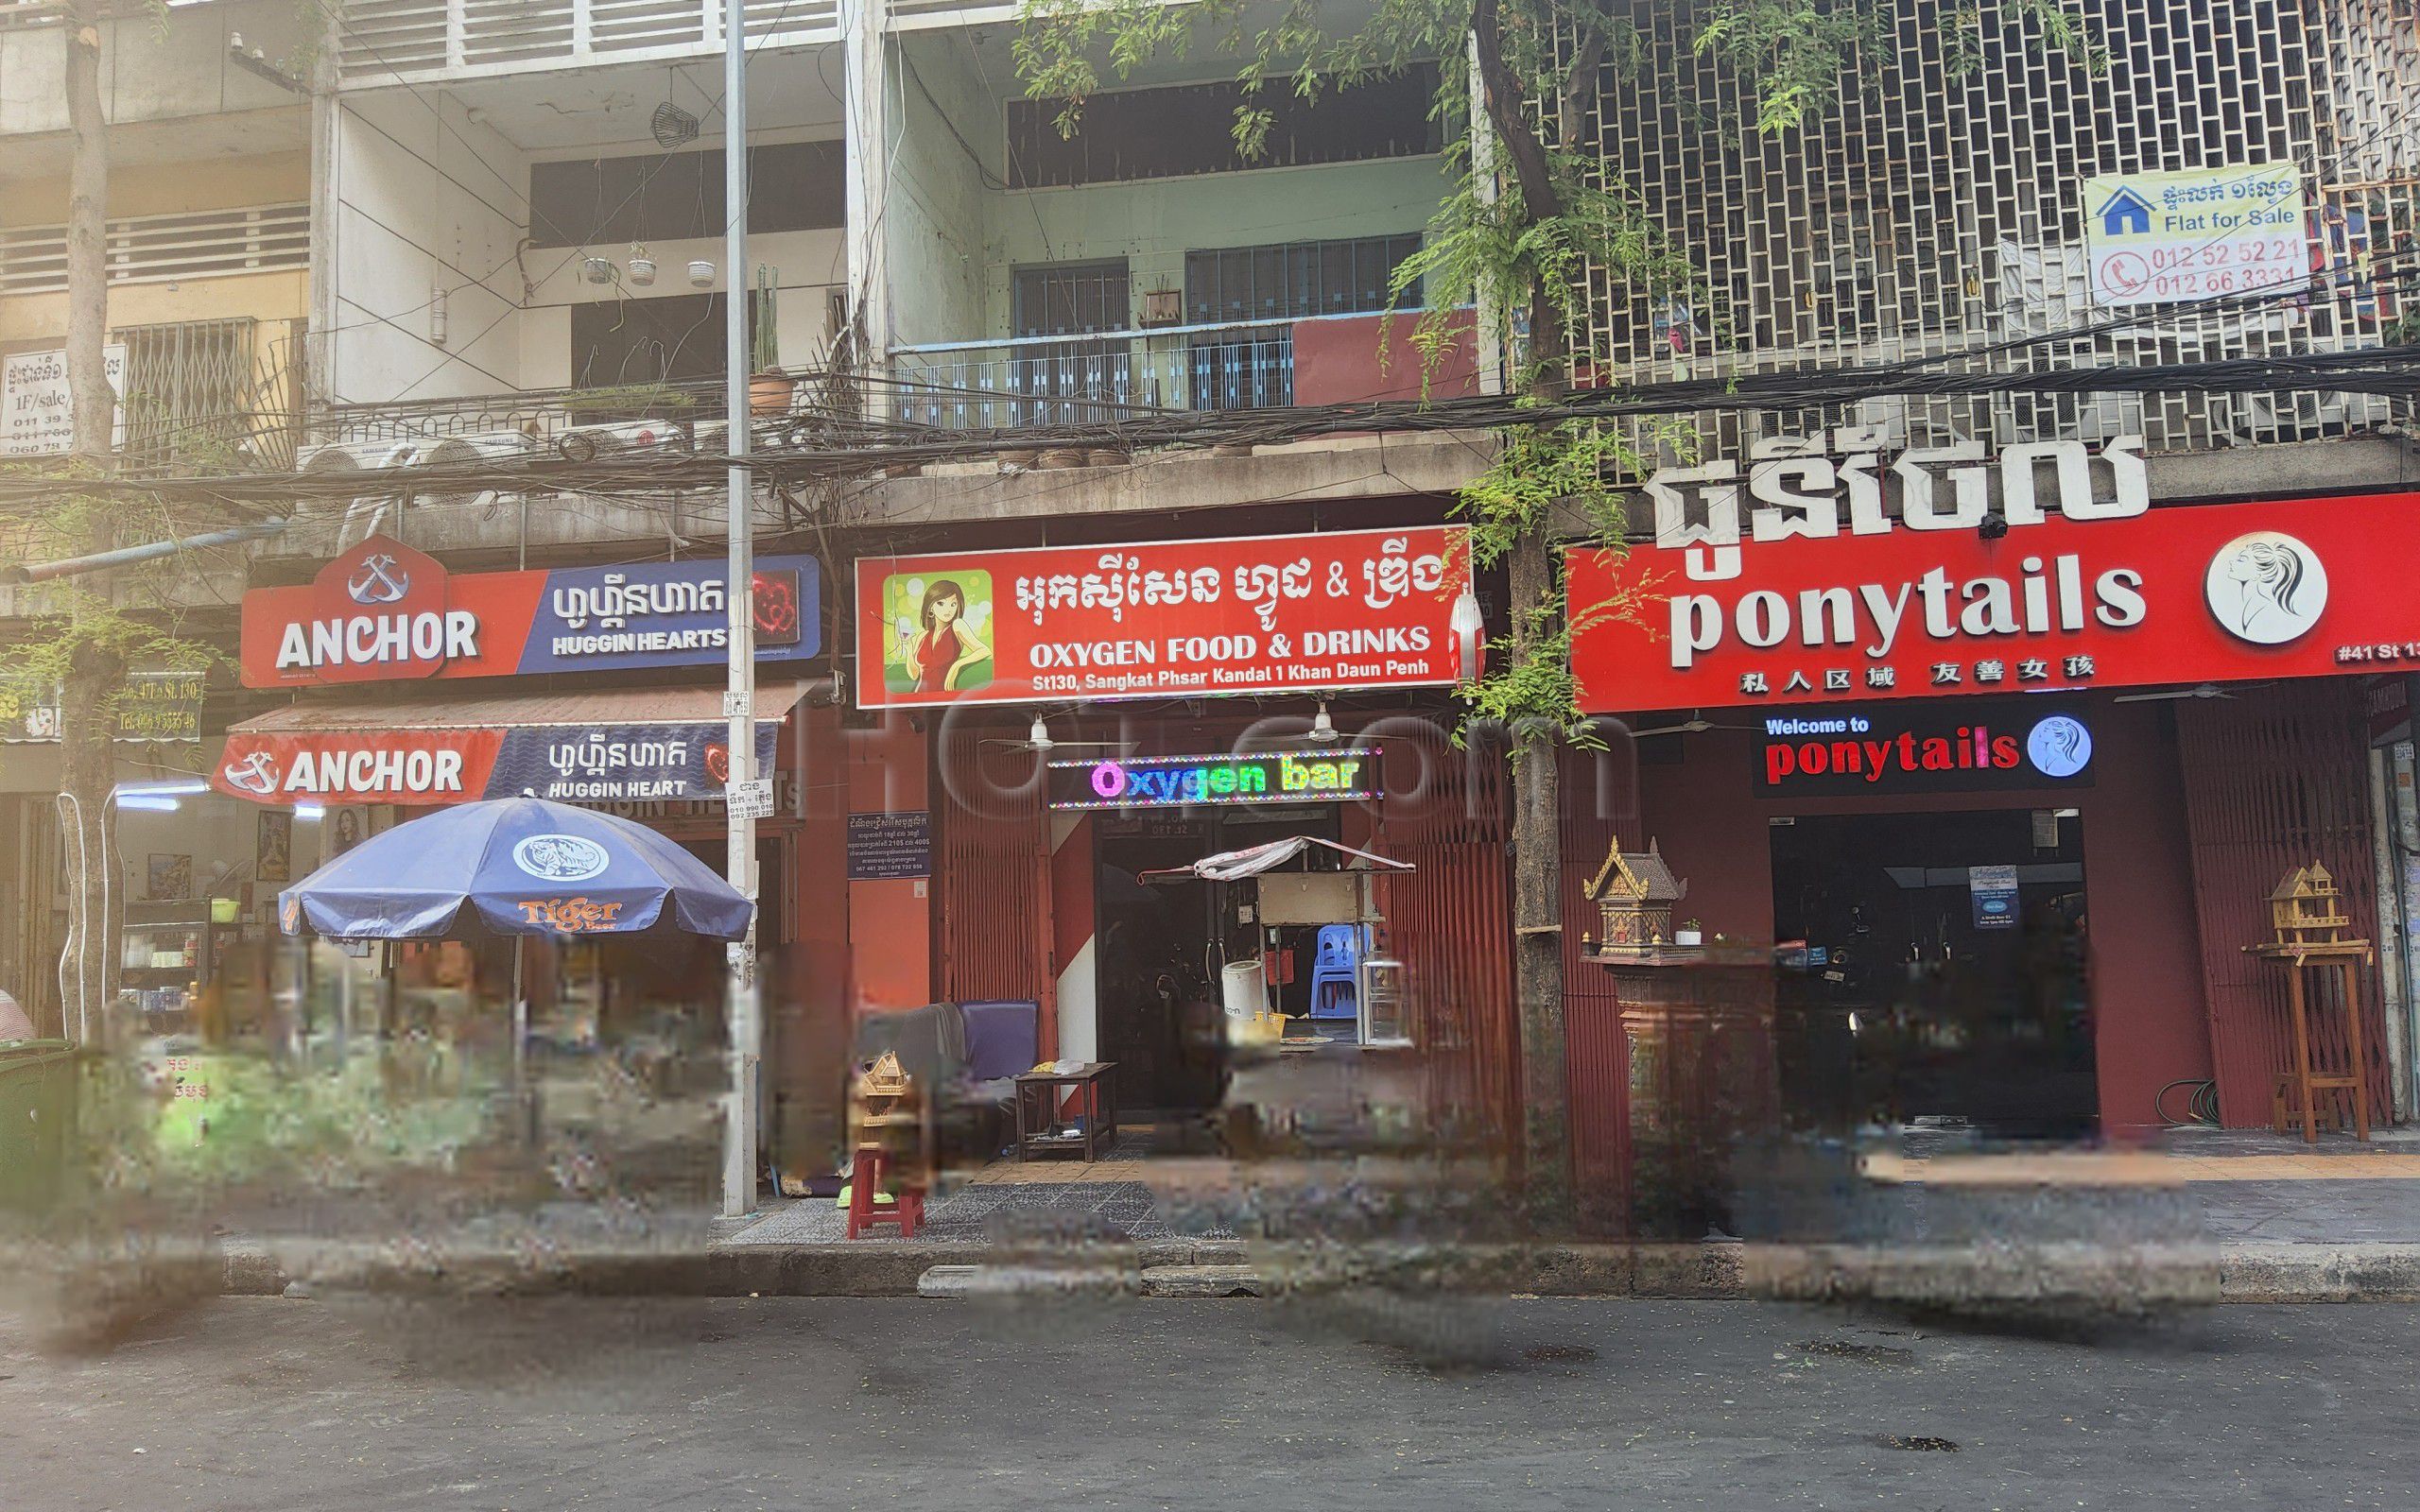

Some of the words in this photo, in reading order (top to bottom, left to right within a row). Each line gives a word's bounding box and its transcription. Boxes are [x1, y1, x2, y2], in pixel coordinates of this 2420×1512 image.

[2165, 214, 2205, 232] Flat
[2212, 212, 2240, 228] for
[2249, 208, 2295, 226] Sale
[2152, 247, 2194, 269] 012
[2203, 244, 2229, 266] 52
[2238, 241, 2266, 263] 52
[2273, 238, 2300, 261] 21
[2155, 274, 2198, 296] 012
[2206, 270, 2234, 293] 66
[13, 417, 38, 427] 011
[9, 445, 40, 455] 060
[1326, 560, 1350, 597] &
[1669, 554, 2148, 668] ponytails
[275, 610, 478, 668] ANCHOR
[552, 632, 636, 656] HUGGIN
[638, 628, 728, 651] HEARTS
[1029, 640, 1155, 668] OXYGEN
[1167, 634, 1257, 662] FOOD
[1268, 632, 1292, 659] &
[1304, 626, 1431, 657] DRINKS
[2338, 645, 2373, 661] #41
[2377, 644, 2400, 659] St
[181, 681, 198, 699] 130
[1032, 675, 1080, 692] St130,
[1085, 672, 1153, 692] Sangkat
[1158, 670, 1208, 686] Phsar
[1213, 666, 1271, 684] Kandal
[1275, 665, 1283, 680] 1
[1288, 663, 1332, 680] Khan
[1337, 662, 1382, 679] Daun
[1386, 659, 1430, 676] Penh
[1740, 666, 1896, 694] 私人区域
[1931, 655, 2096, 685] 友善女孩
[1766, 718, 1846, 735] Welcome
[1850, 716, 1870, 732] to
[284, 749, 462, 792] ANCHOR
[1765, 726, 2021, 784] ponytails
[548, 782, 623, 798] HUGGIN
[628, 780, 687, 798] HEART
[1091, 762, 1267, 802] Oxygen
[1281, 755, 1360, 791] bar
[519, 897, 623, 933] Tiger
